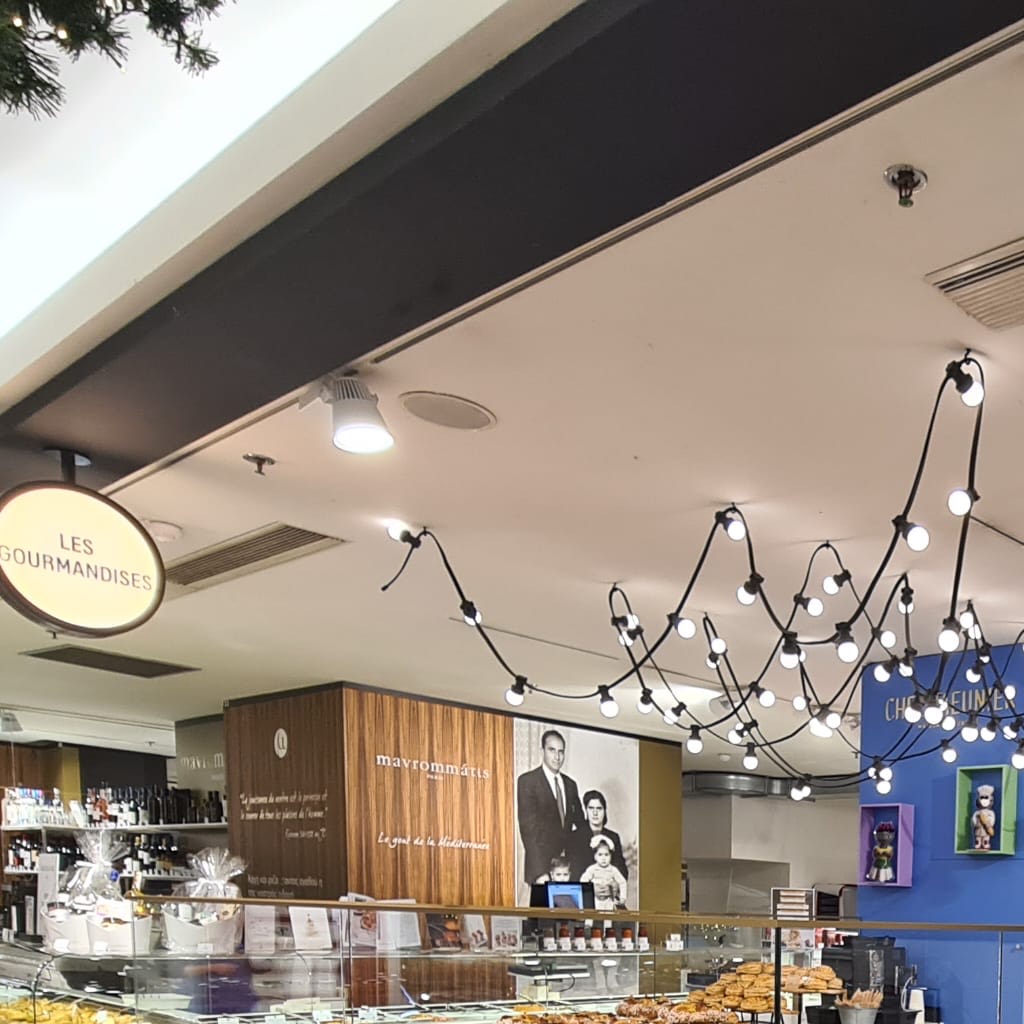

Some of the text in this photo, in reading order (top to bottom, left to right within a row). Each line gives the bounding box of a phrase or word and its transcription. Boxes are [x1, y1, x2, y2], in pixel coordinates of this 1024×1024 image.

[59, 533, 94, 556] LES
[0, 544, 153, 591] GOURMANDISES
[413, 836, 424, 846] de
